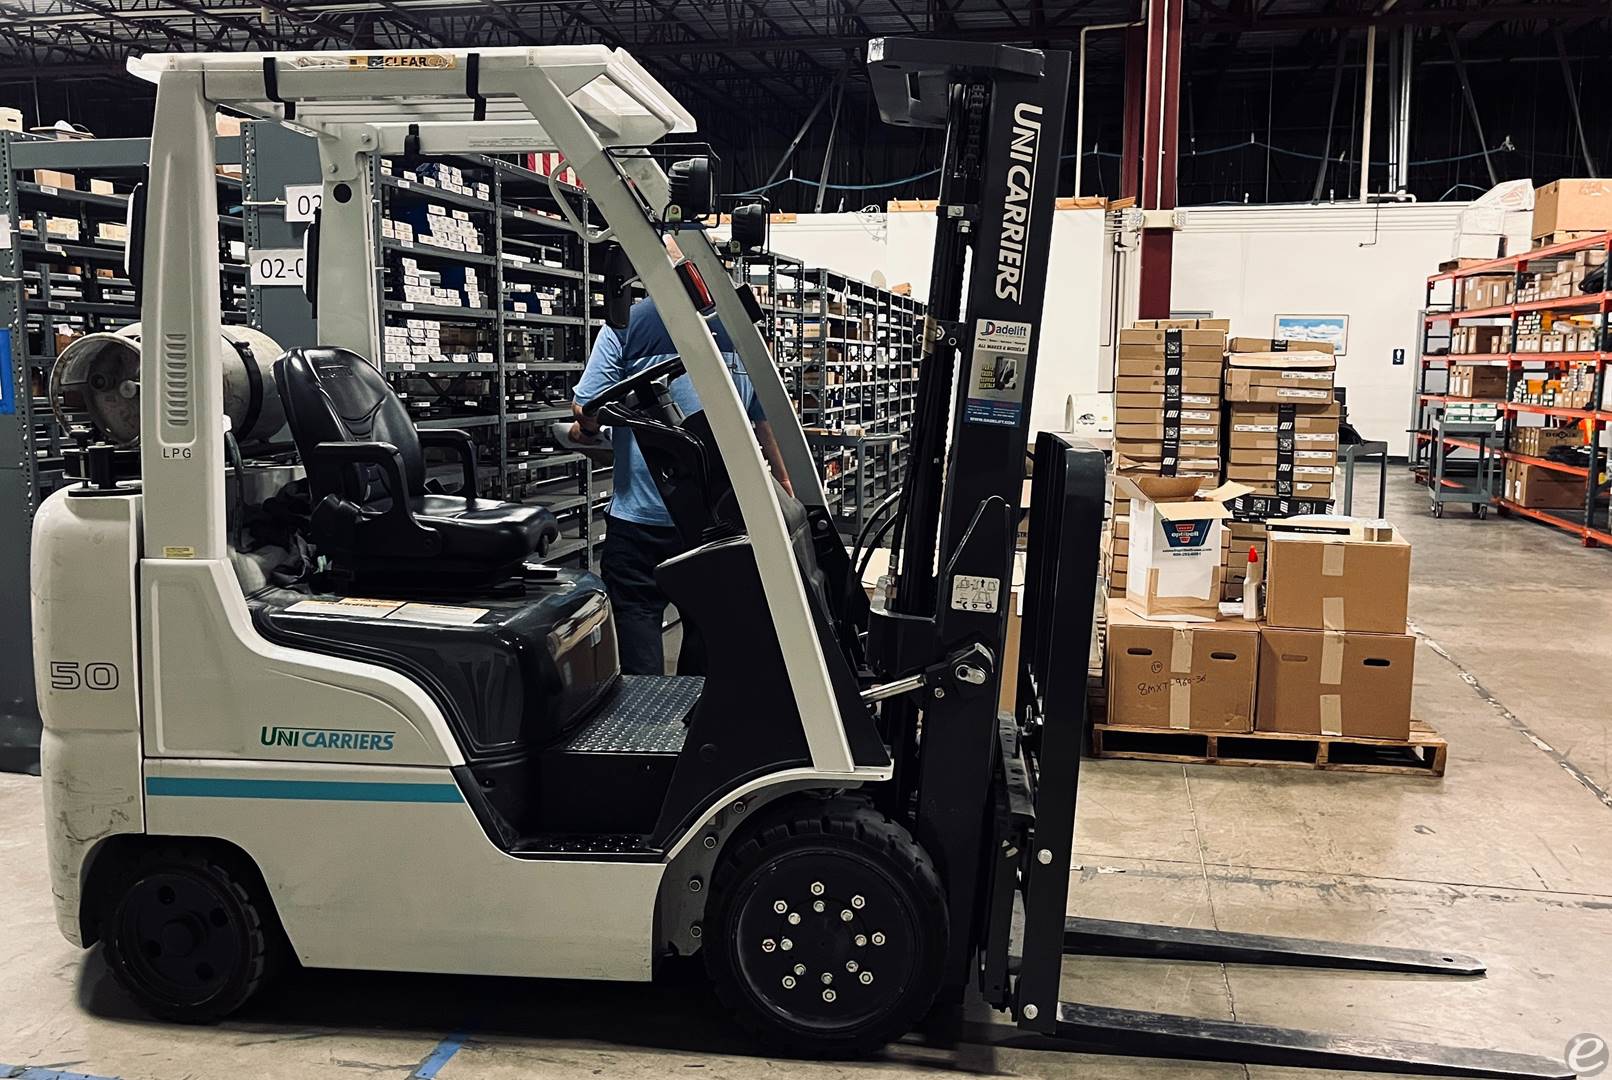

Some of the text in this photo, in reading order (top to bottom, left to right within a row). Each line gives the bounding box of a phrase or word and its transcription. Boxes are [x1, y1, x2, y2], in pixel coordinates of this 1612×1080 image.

[981, 321, 1027, 336] Dadelift
[163, 448, 192, 459] LPG
[50, 661, 119, 690] 50
